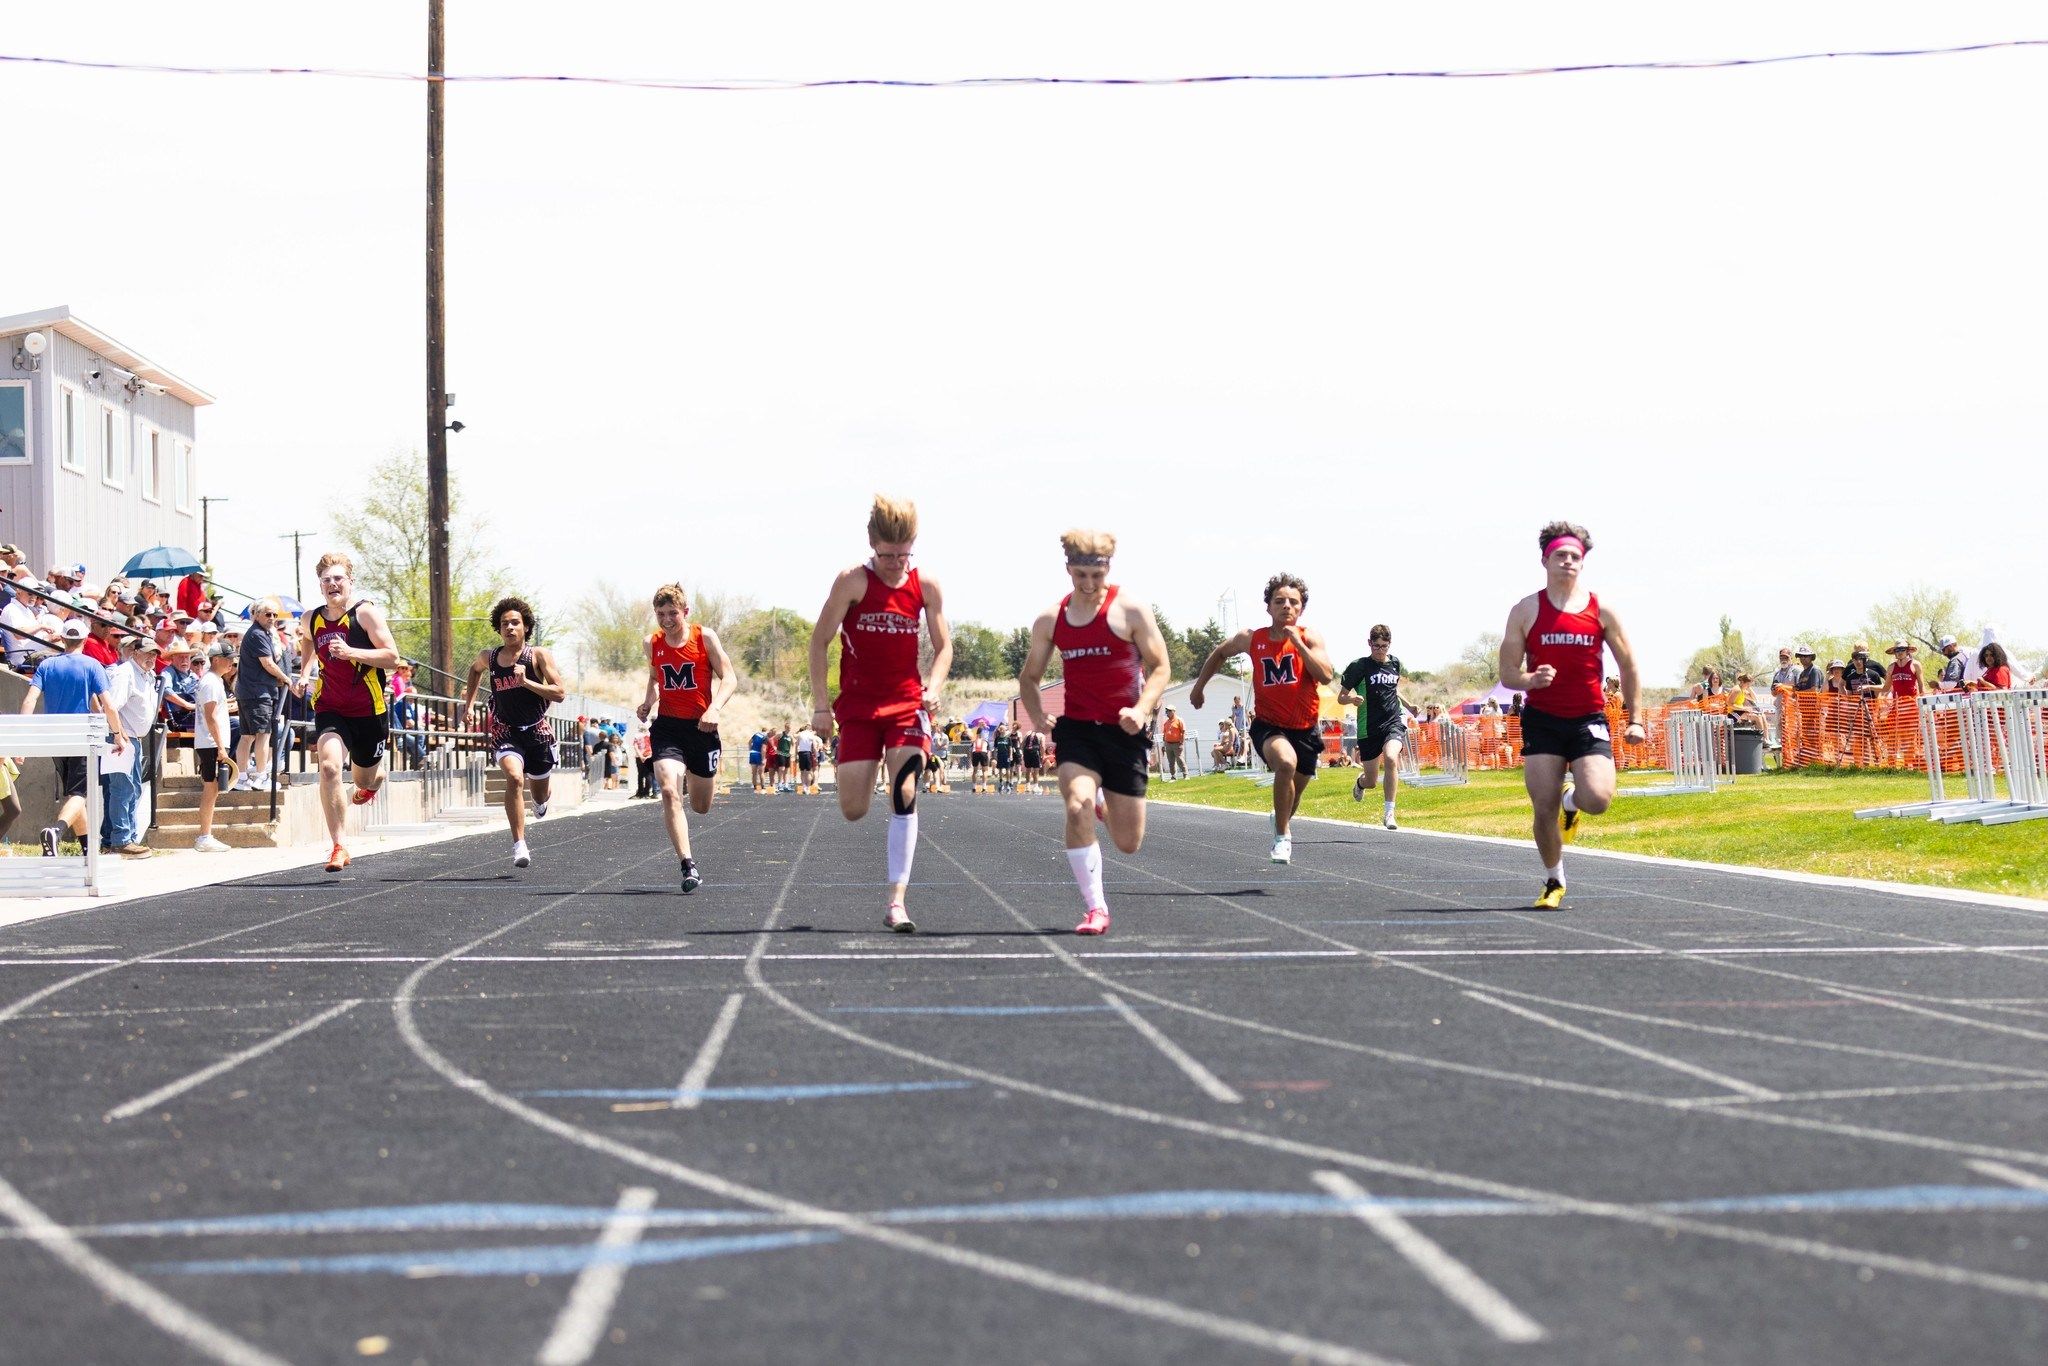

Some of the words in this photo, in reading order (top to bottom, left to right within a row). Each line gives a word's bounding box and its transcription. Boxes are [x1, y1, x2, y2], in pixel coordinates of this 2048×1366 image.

[860, 612, 920, 626] POTTER-D
[660, 662, 698, 690] M
[1260, 653, 1298, 687] M
[494, 675, 522, 691] RAM
[377, 741, 384, 756] 8
[711, 751, 718, 769] 6
